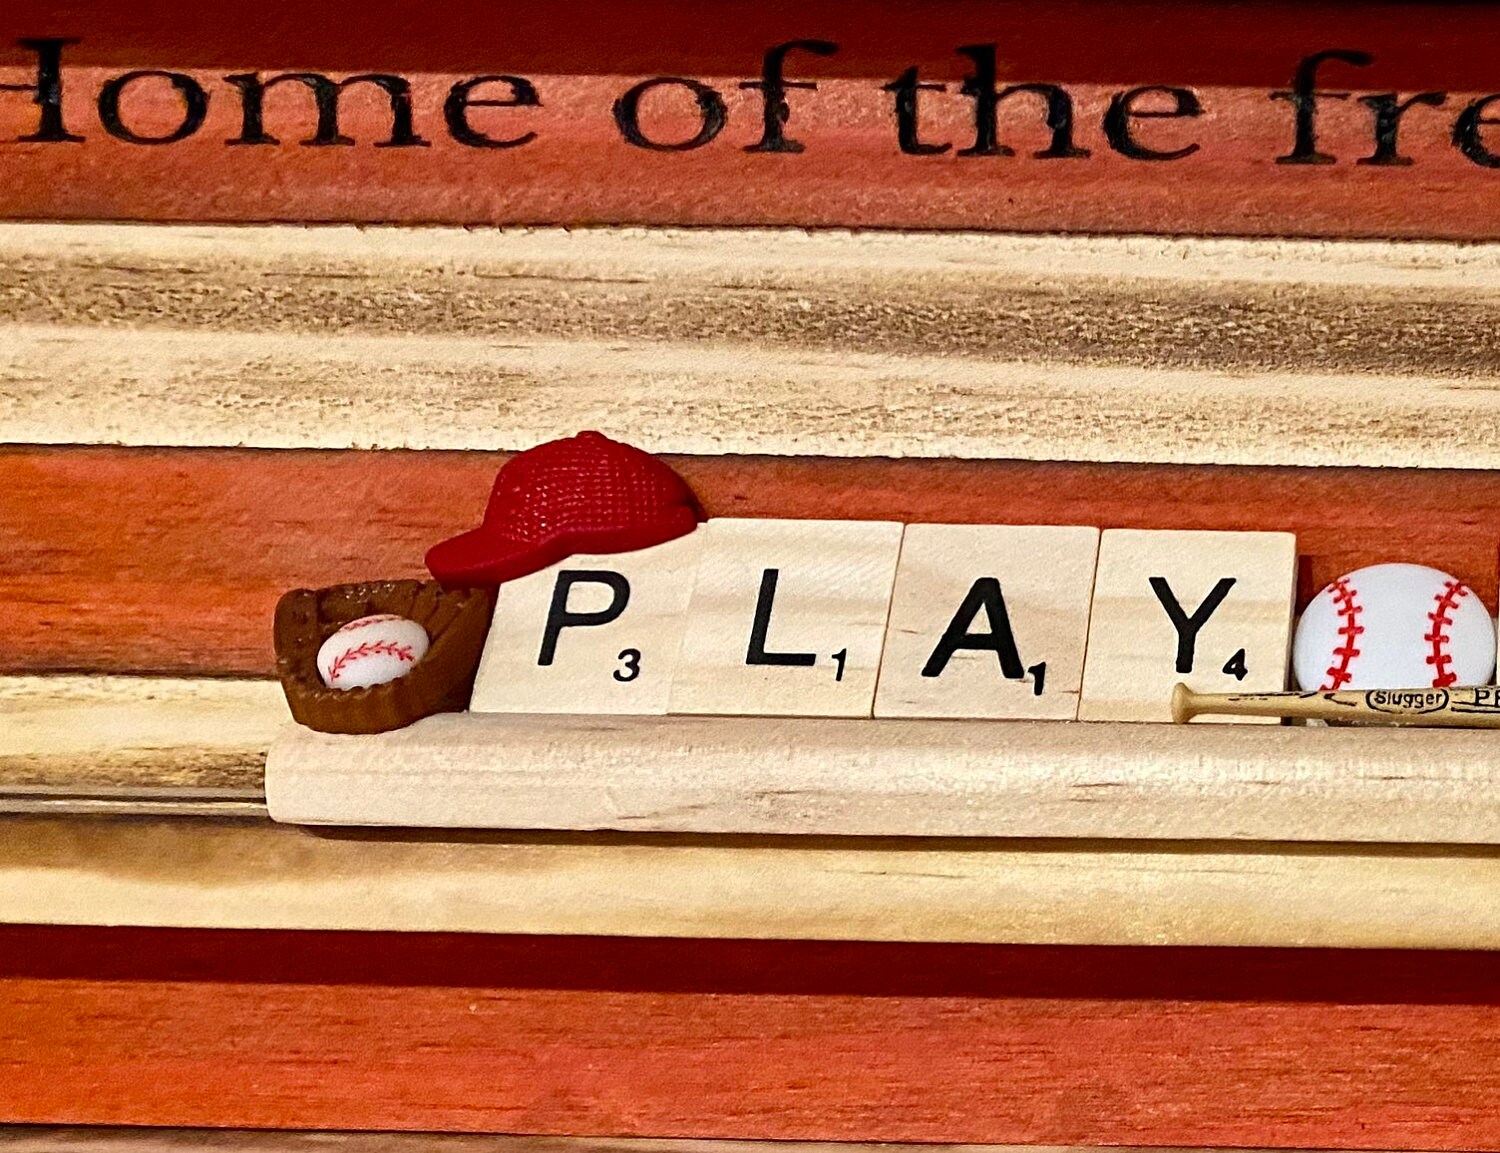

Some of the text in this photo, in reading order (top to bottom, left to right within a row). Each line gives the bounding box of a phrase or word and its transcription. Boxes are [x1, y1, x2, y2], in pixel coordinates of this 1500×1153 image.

[612, 37, 841, 153] of
[883, 41, 1202, 161] the
[1373, 689, 1442, 709] Slugger
